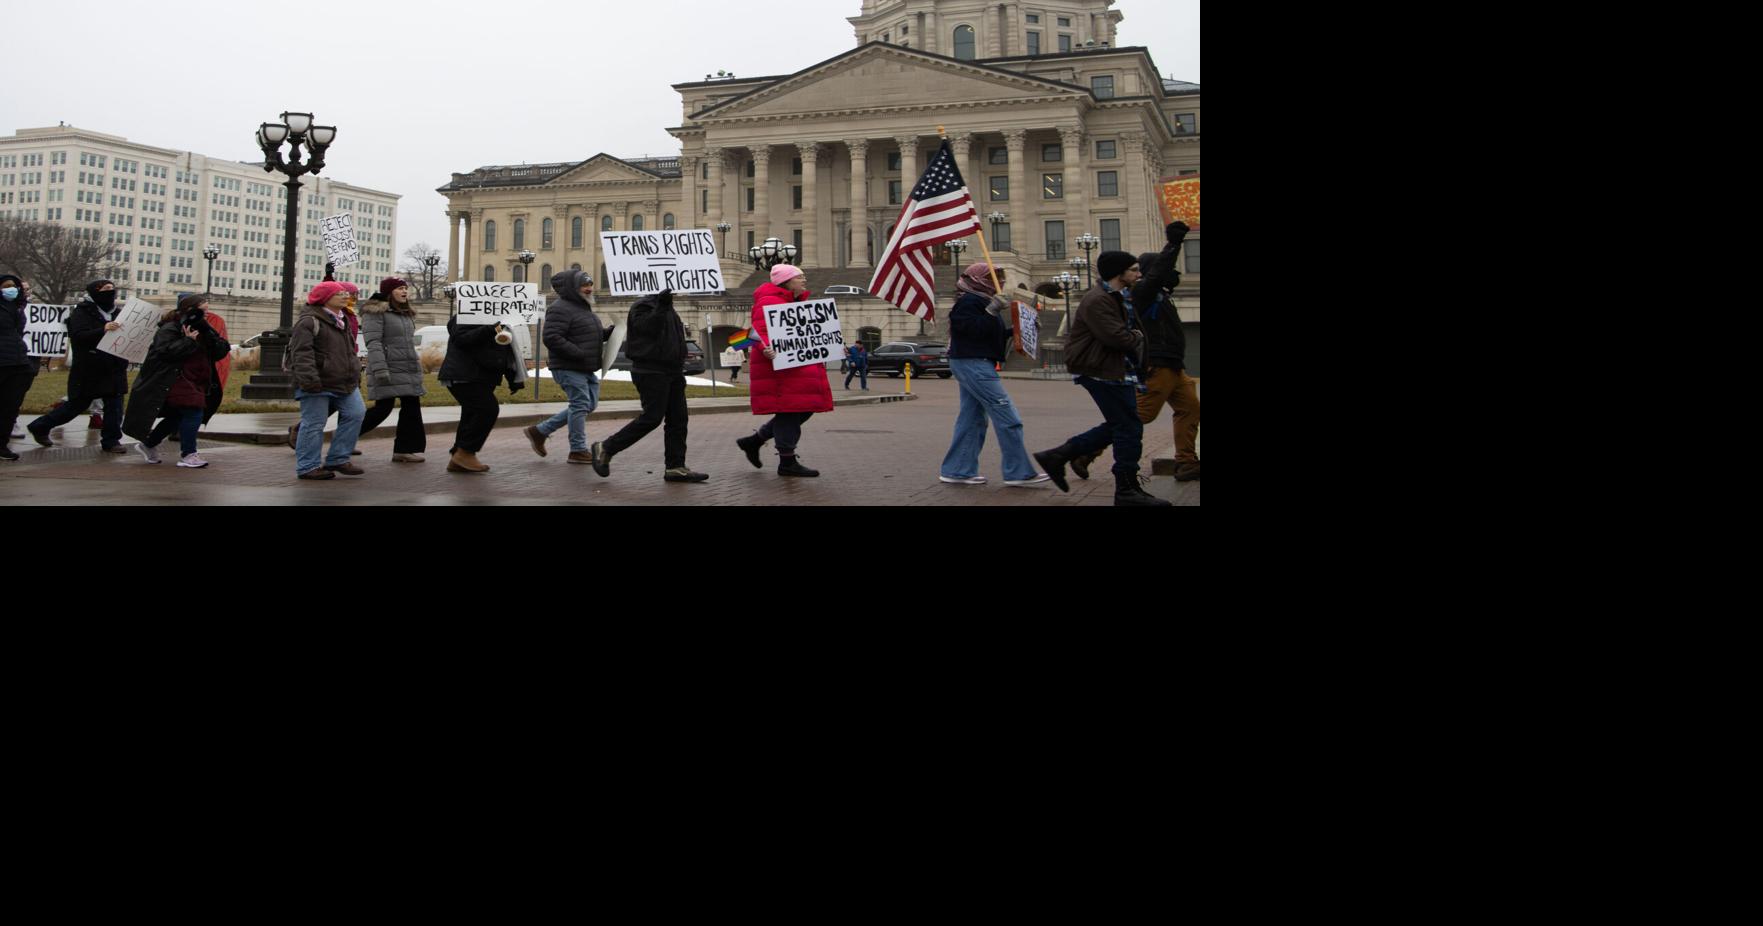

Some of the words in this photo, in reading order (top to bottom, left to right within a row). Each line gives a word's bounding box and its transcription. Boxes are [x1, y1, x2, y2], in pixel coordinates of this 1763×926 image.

[320, 214, 352, 233] REJECT
[323, 228, 355, 245] FASCISM
[603, 234, 660, 256] TRANS
[662, 232, 715, 255] RIGHTS
[326, 239, 357, 255] DEFEND
[329, 252, 360, 266] EQUALITY
[612, 270, 660, 292] HUMAN
[664, 269, 719, 291] RIGHTS
[459, 284, 527, 299] QUEER
[30, 305, 67, 323] BODY
[458, 300, 538, 316] LIBERATION
[768, 301, 838, 327] FASCISM
[796, 323, 822, 337] BAD
[771, 337, 809, 353] HUMAN
[810, 330, 843, 347] RIGHTS
[796, 347, 829, 363] GOOD
